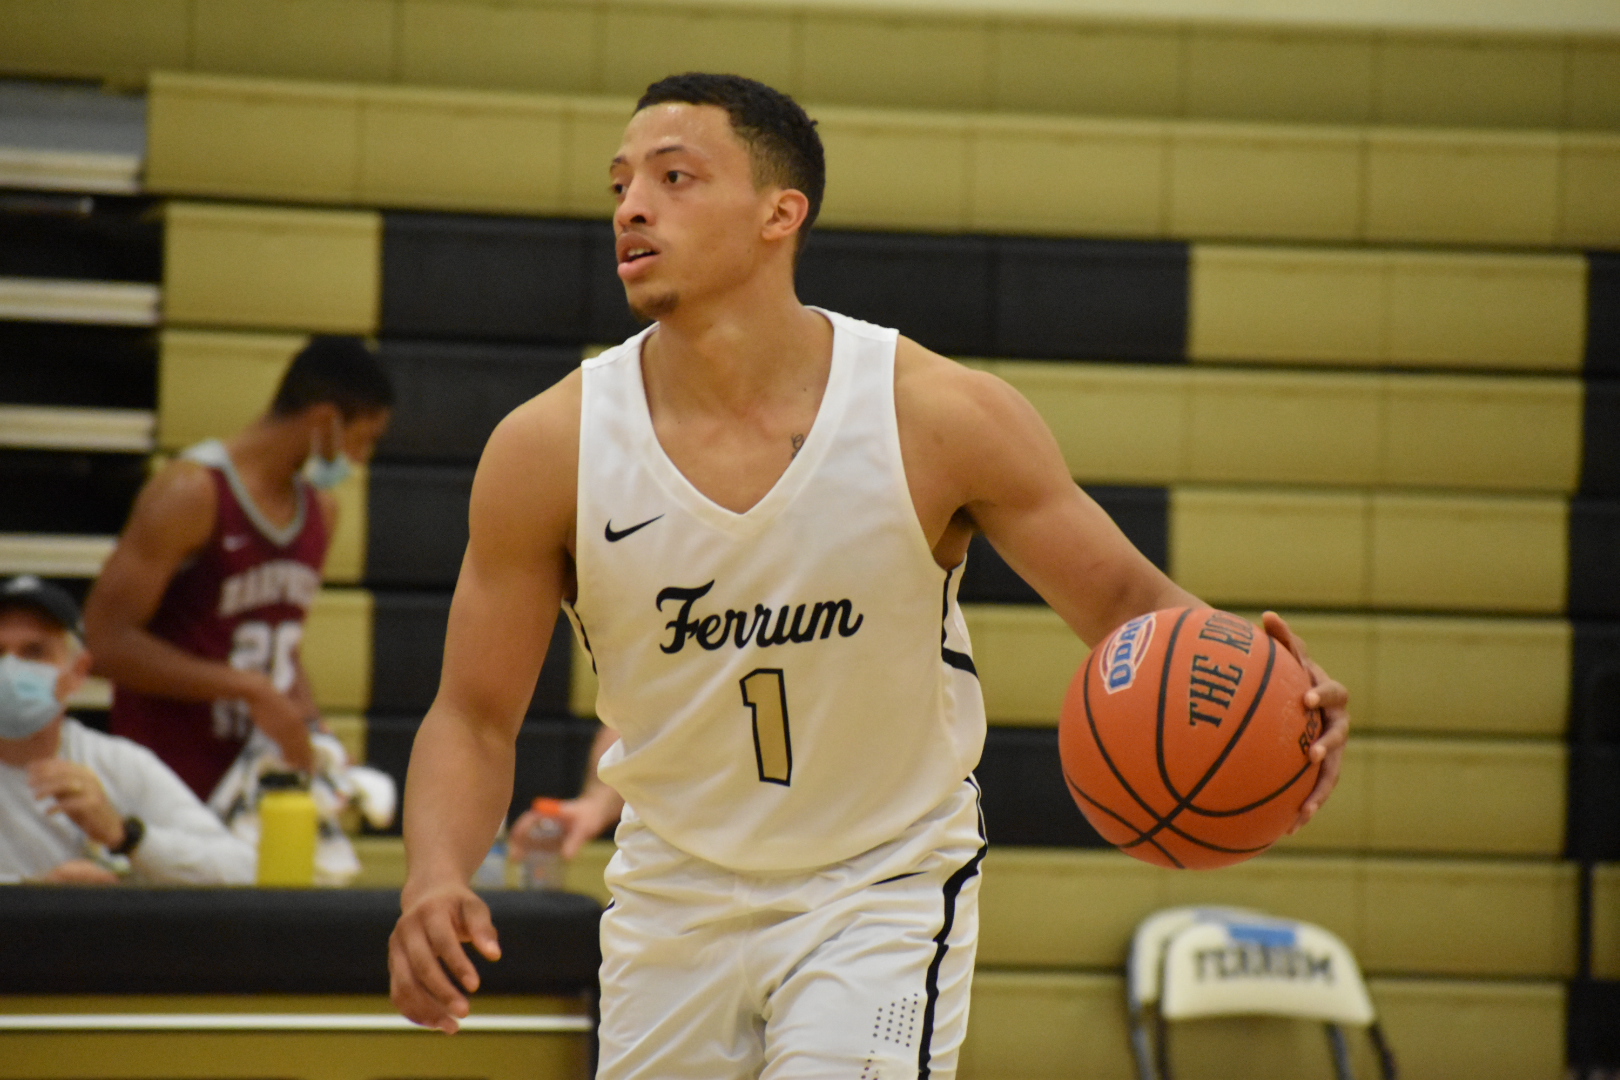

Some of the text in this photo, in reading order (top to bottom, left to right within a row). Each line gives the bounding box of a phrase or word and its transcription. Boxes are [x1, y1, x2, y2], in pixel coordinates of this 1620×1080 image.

[656, 579, 863, 654] Ferrum
[739, 668, 792, 787] 1
[1189, 654, 1243, 728] THE
